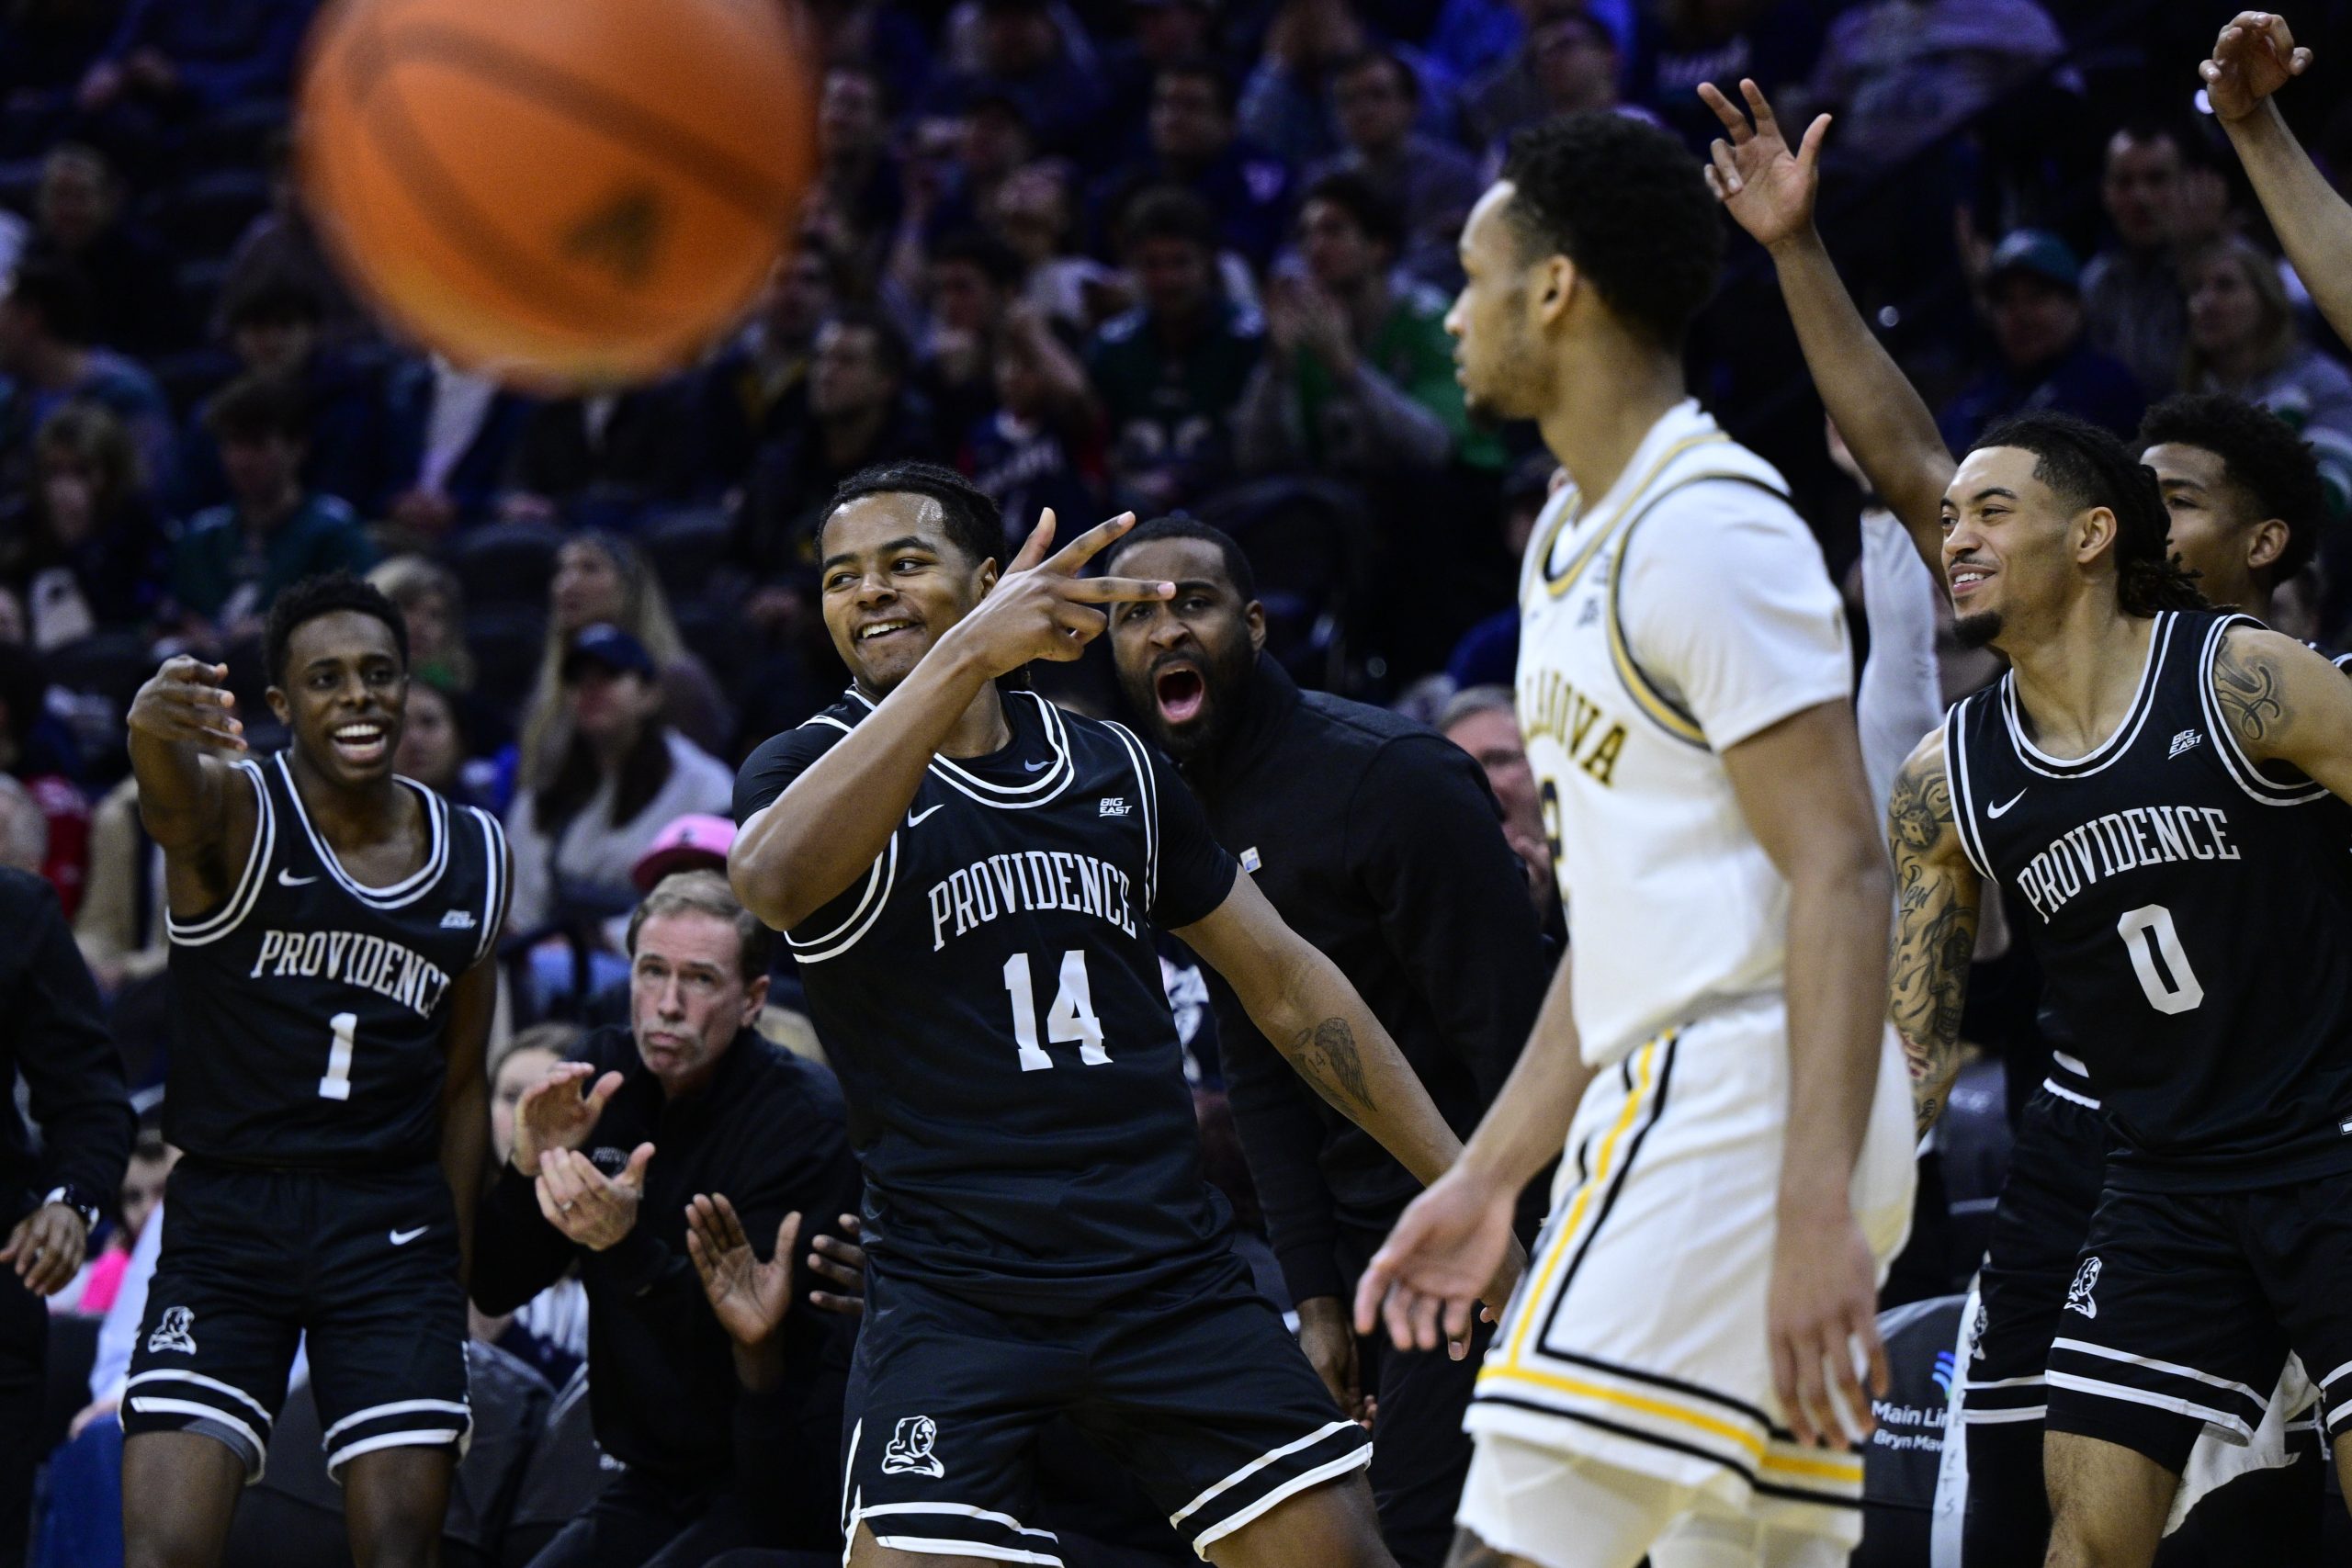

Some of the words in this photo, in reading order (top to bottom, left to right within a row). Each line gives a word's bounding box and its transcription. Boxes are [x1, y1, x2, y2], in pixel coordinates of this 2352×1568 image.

[2168, 734, 2203, 754] EAST
[1099, 806, 1132, 815] EAST
[1100, 797, 1124, 807] BIG
[2017, 806, 2242, 924] PROVIDENCE
[928, 851, 1136, 952] PROVIDENCE
[2117, 904, 2205, 1015] 0
[1003, 949, 1114, 1072] 14
[318, 1011, 357, 1100] 1
[1871, 1399, 1922, 1426] Main
[1873, 1428, 1913, 1450] Bryn
